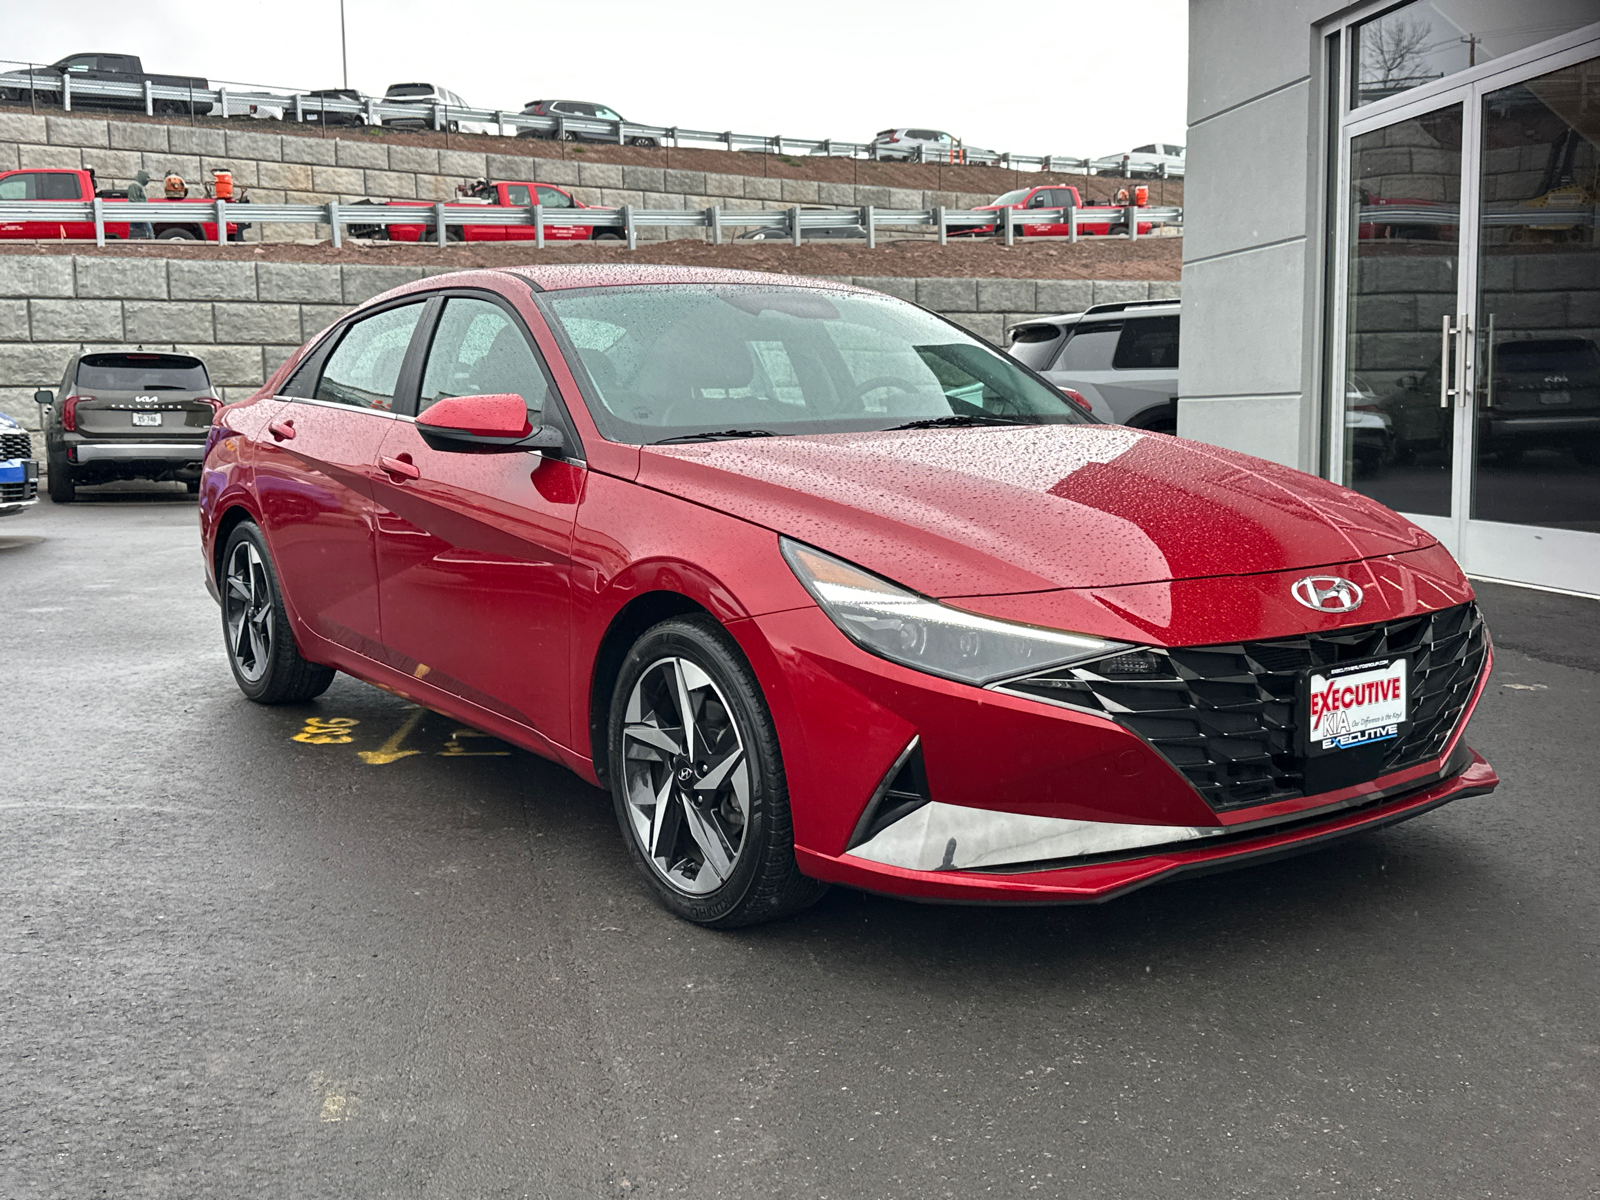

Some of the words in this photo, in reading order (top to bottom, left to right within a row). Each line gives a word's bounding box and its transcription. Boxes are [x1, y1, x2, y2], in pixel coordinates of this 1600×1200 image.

[1311, 676, 1401, 732] EXECUTIVE
[1323, 711, 1351, 737] KIA
[1351, 719, 1360, 727] Our
[1360, 716, 1380, 727] Difference
[1322, 724, 1397, 749] EXECUTIVE
